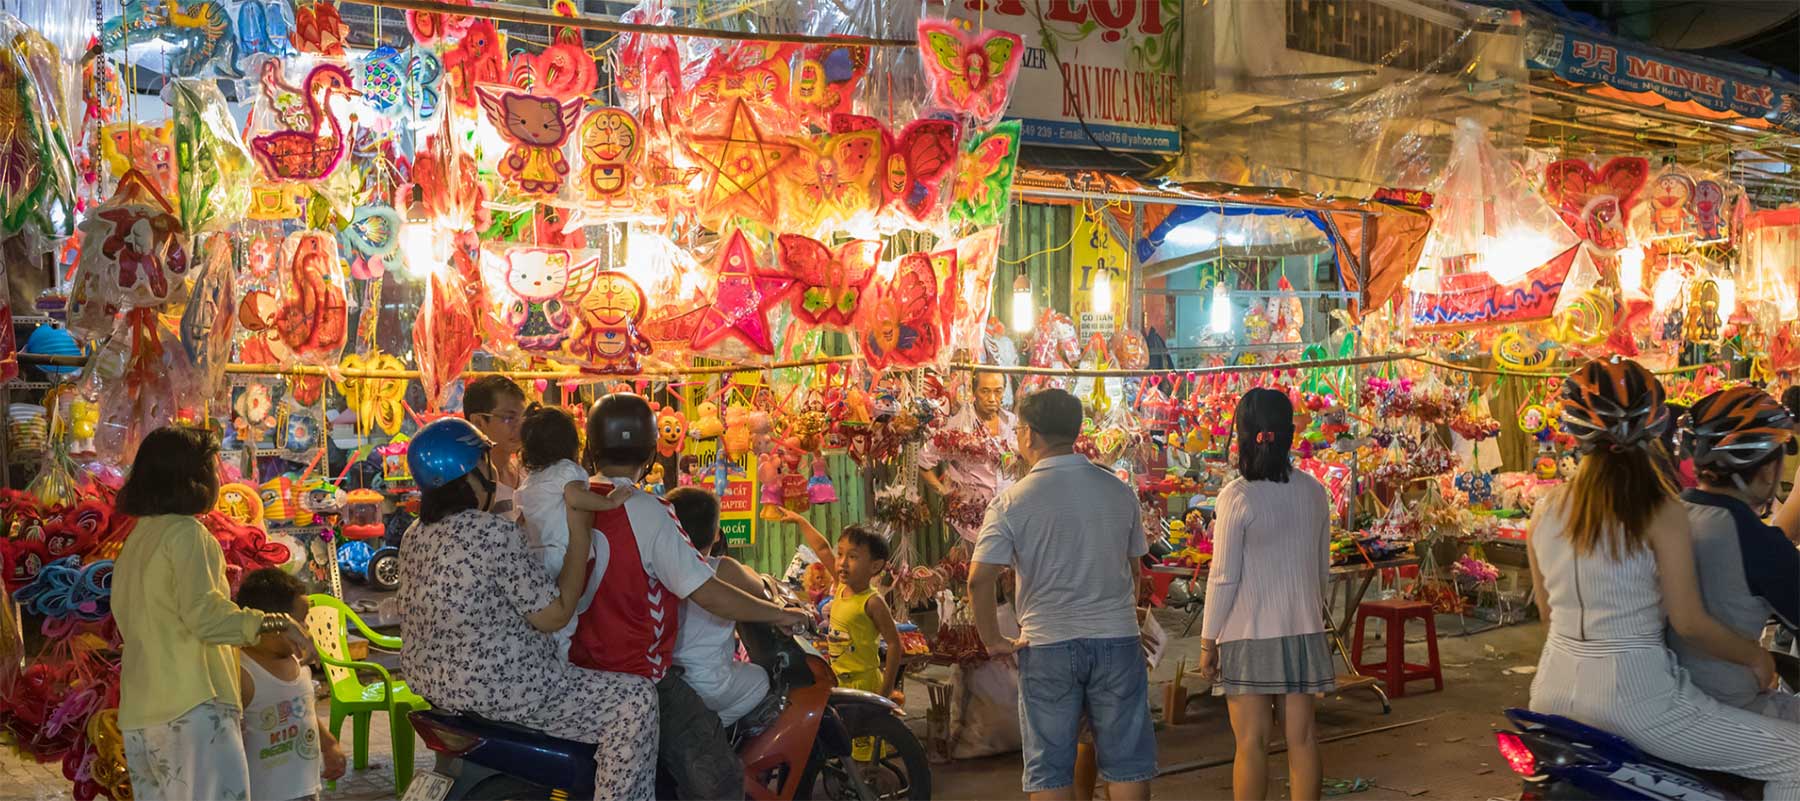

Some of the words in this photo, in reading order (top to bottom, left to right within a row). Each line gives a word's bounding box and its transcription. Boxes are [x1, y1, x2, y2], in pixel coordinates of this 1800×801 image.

[1573, 41, 1617, 74] 明
[1626, 55, 1726, 98] MINH
[1094, 65, 1131, 123] MICA
